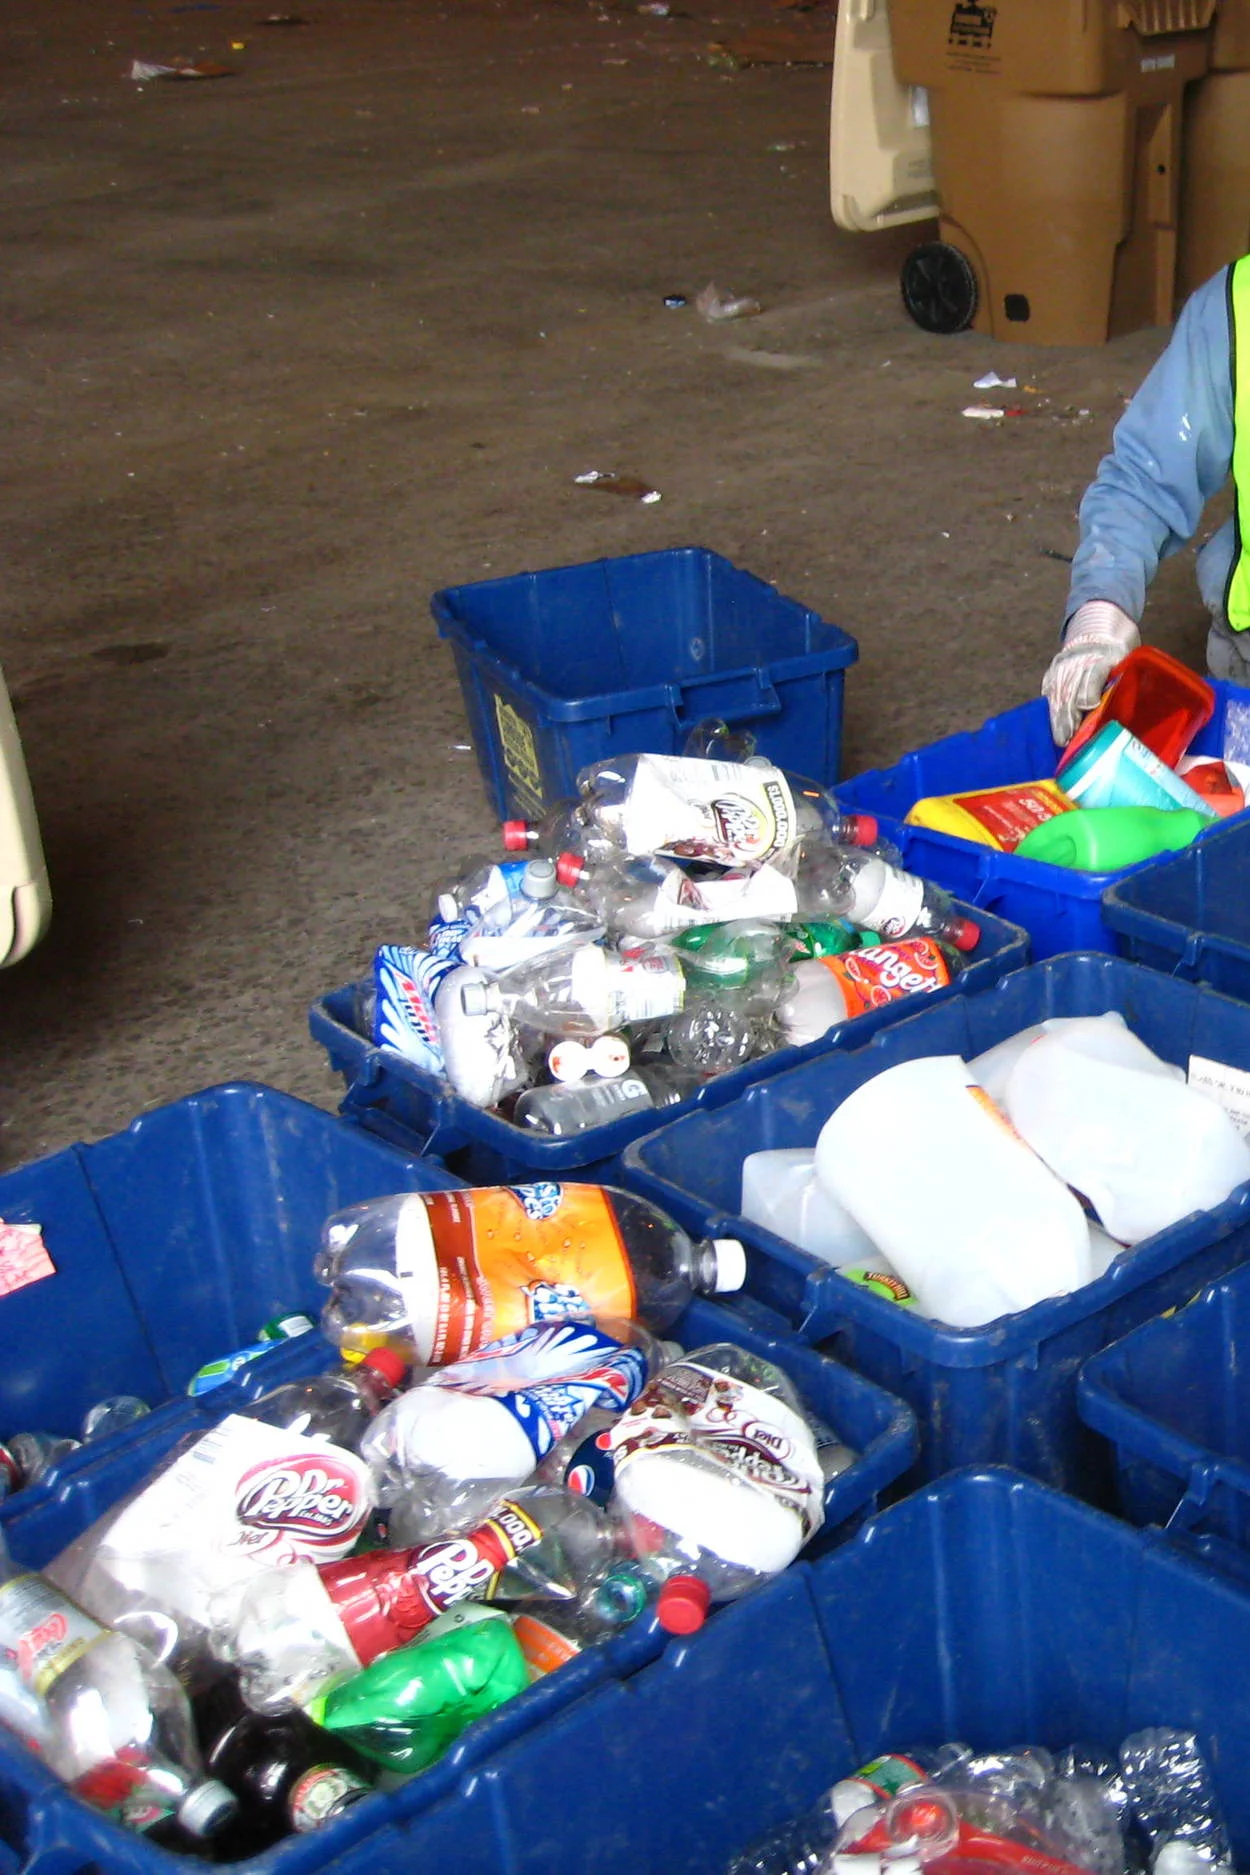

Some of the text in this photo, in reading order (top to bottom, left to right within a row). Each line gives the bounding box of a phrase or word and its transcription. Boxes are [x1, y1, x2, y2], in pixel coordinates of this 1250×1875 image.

[754, 1428, 783, 1450] Diet
[240, 1469, 354, 1520] Pepper
[300, 1469, 346, 1495] Dr
